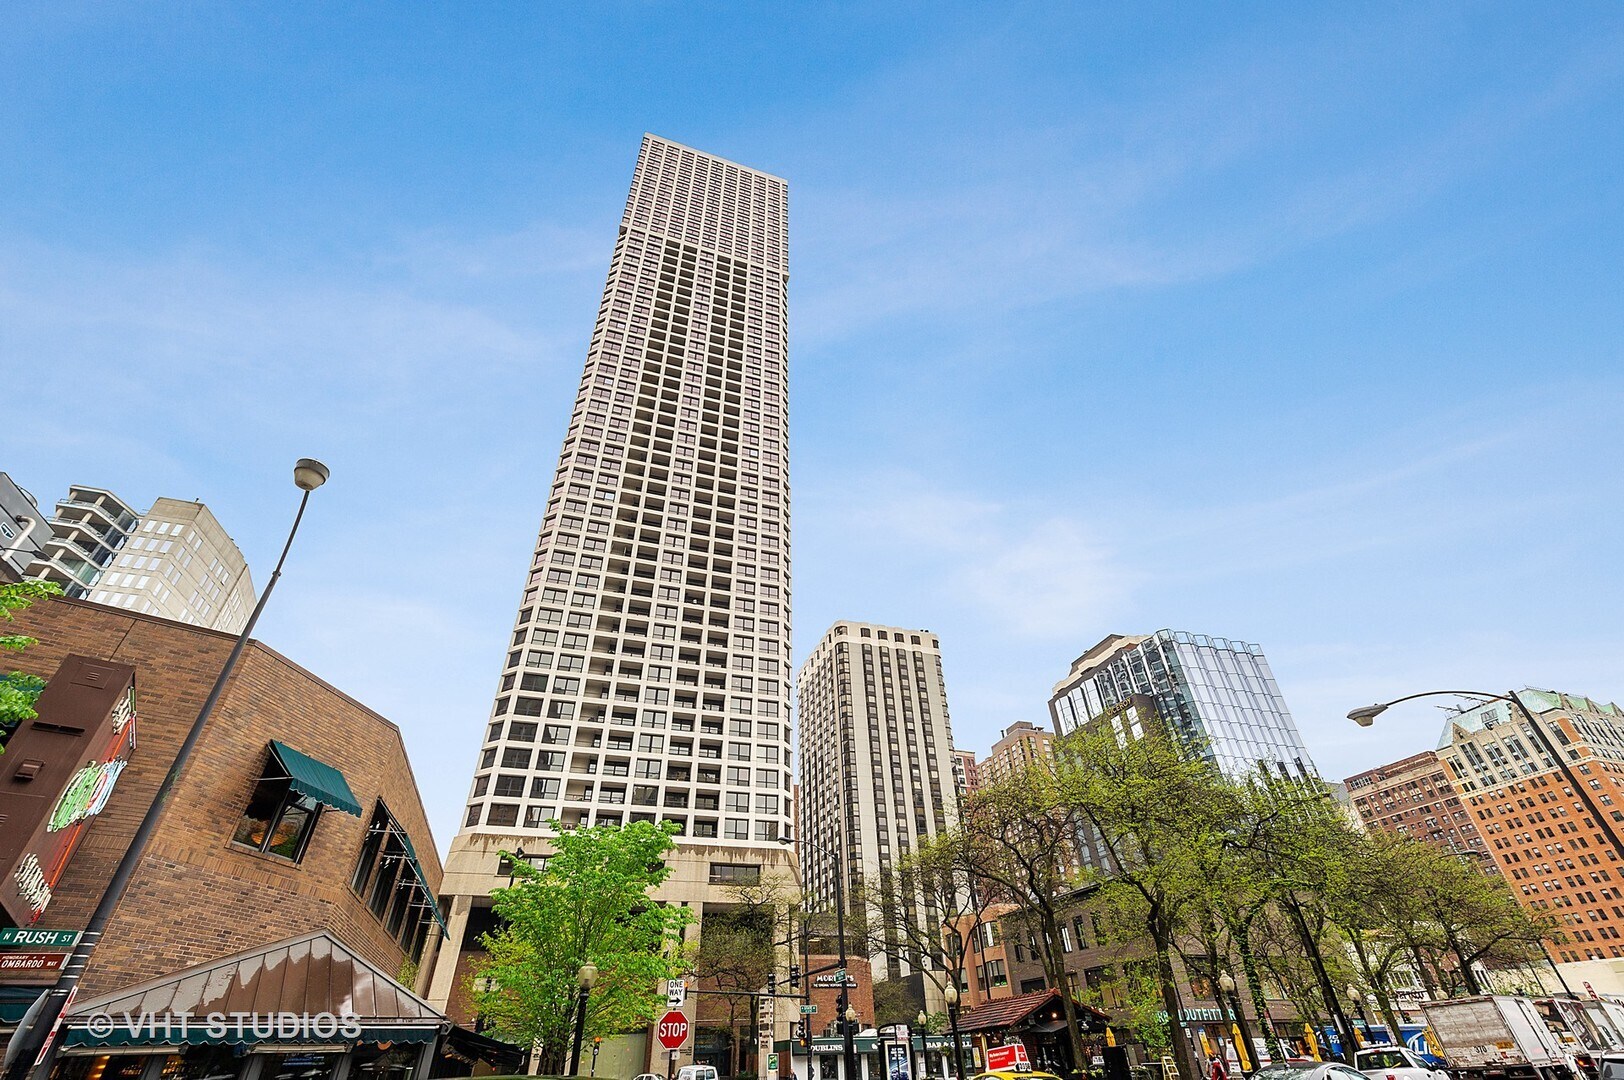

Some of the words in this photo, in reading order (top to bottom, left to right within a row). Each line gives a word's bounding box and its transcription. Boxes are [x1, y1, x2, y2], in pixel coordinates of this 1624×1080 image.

[3, 932, 12, 941] N
[13, 930, 59, 944] RUSH
[61, 934, 73, 943] ST
[0, 959, 44, 969] OMBARDO
[669, 980, 684, 988] ONE
[659, 1022, 688, 1038] STOP
